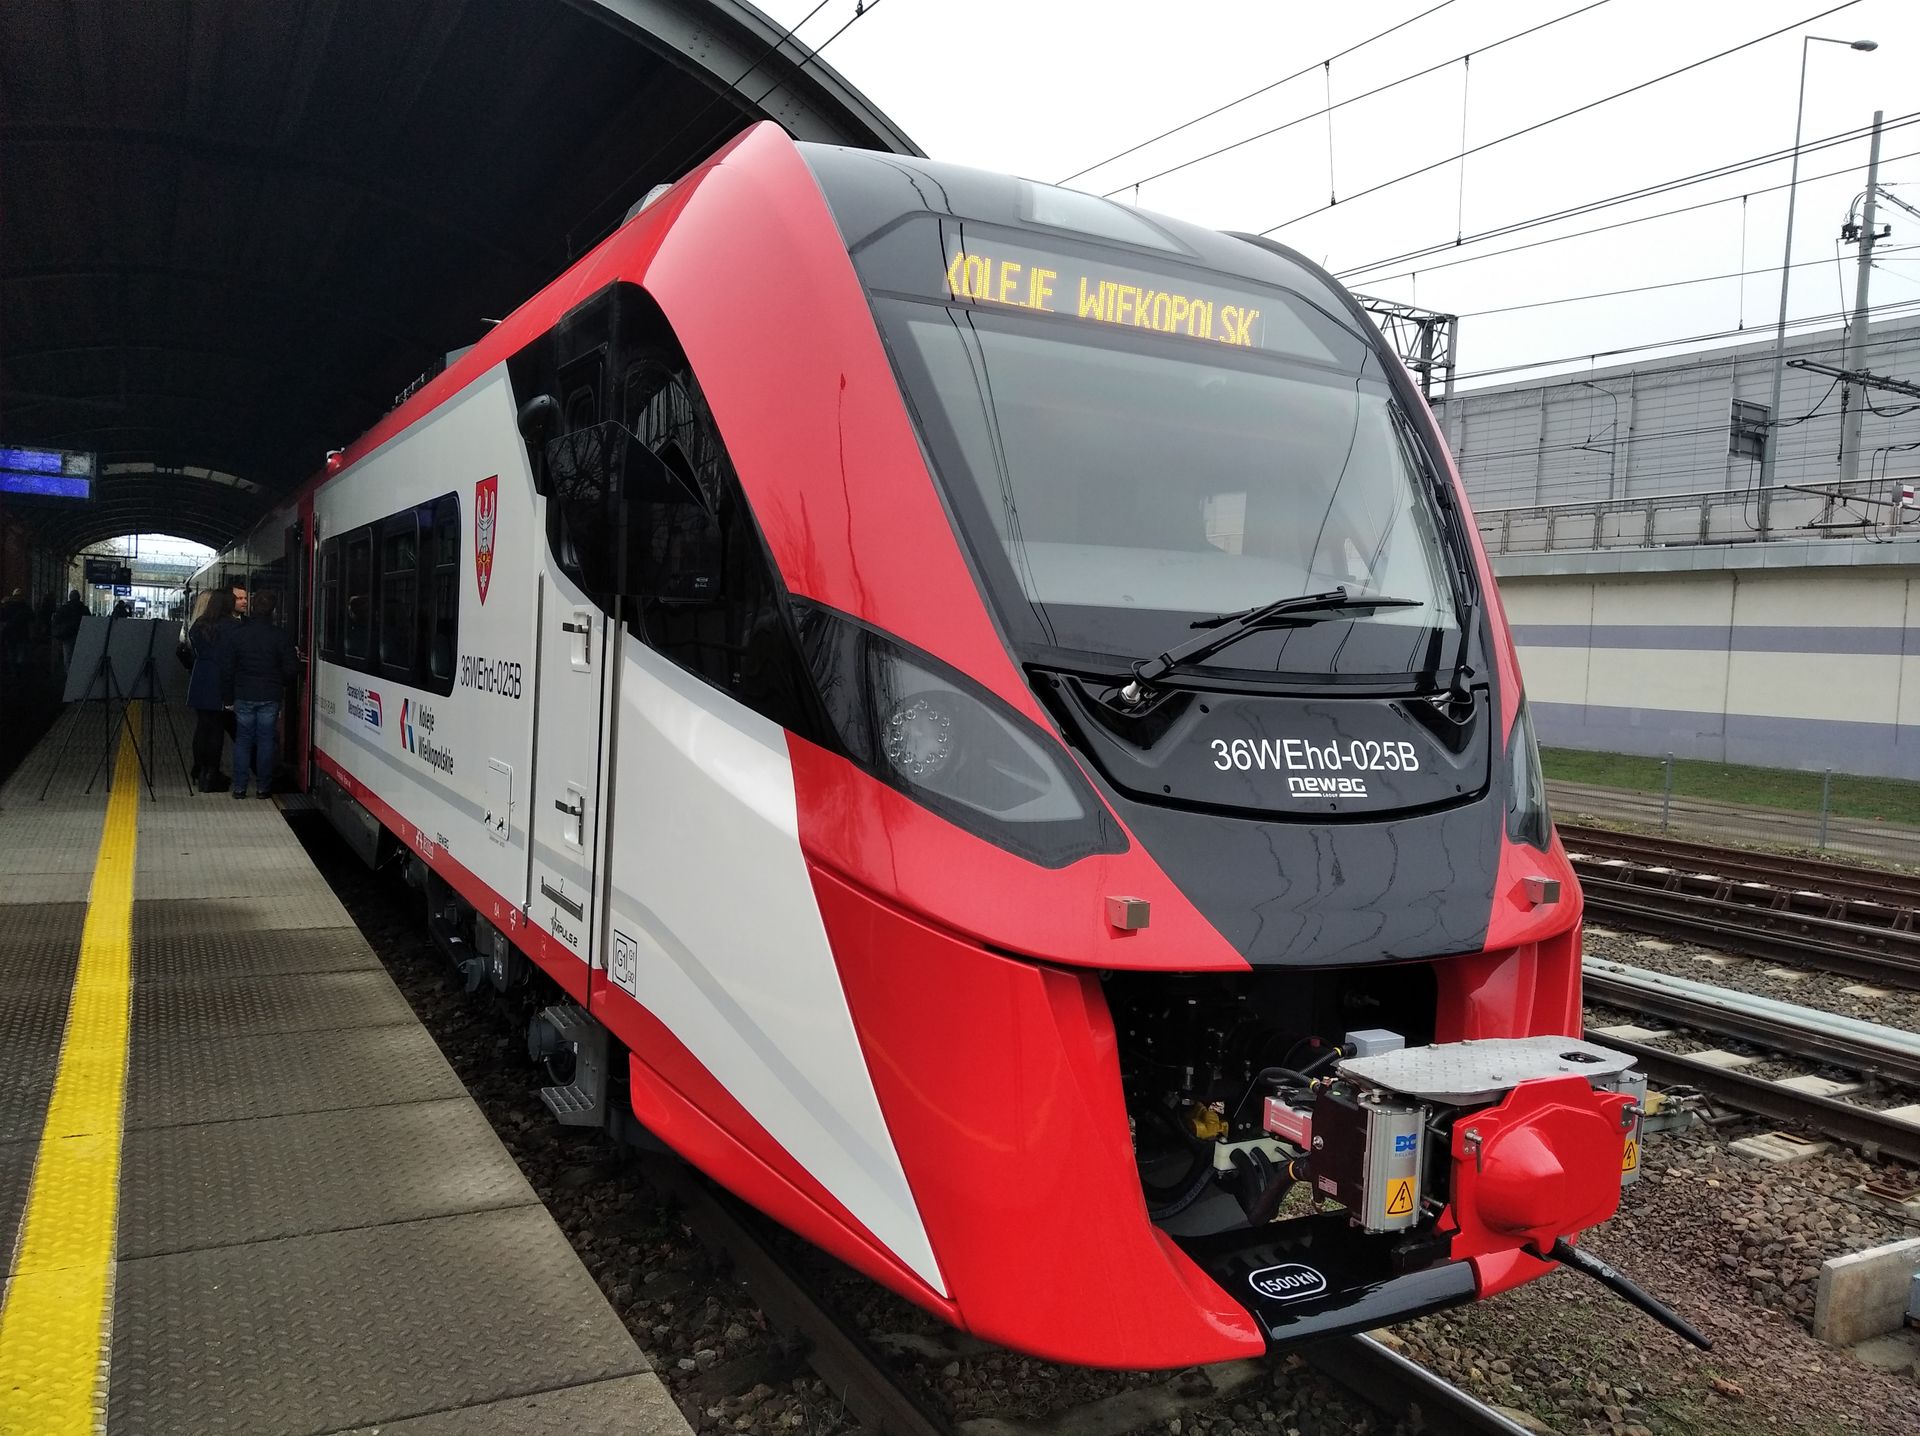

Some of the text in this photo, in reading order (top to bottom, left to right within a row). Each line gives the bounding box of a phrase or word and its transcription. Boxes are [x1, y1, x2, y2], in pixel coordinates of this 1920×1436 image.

[946, 251, 1057, 312] KOLEJE
[460, 654, 522, 700] 36WEhd-025B
[419, 703, 434, 736] Koleje
[418, 735, 454, 776] Wielkopolskie
[1210, 738, 1419, 772] 36WEhd-025B
[1259, 1271, 1320, 1293] 1500kN
